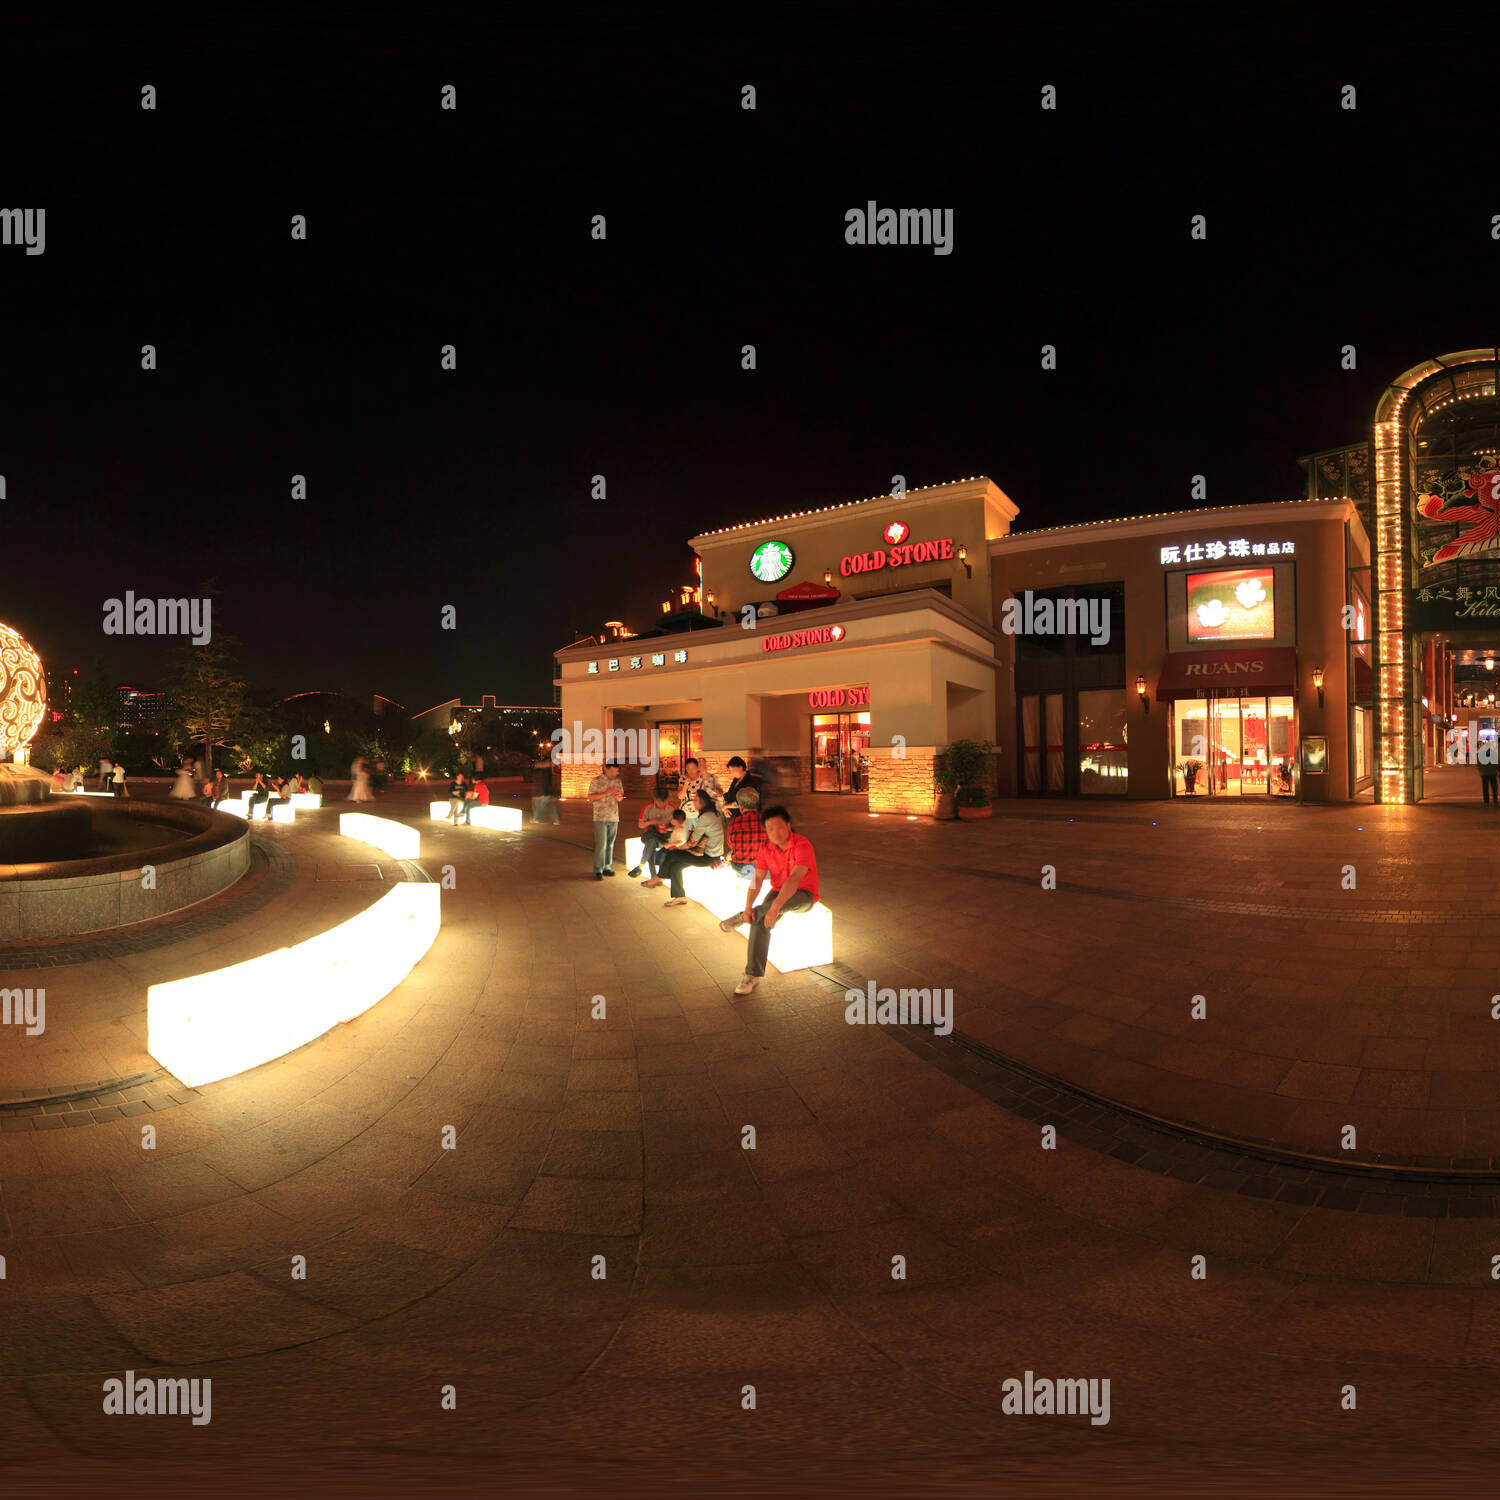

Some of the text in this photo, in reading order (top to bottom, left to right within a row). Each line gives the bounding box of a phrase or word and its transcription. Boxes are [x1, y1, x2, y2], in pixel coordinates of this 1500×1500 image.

[840, 538, 954, 577] COLD STONE
[1160, 538, 1295, 564] 阮仕珍珠精品店
[762, 627, 832, 652] COLD STONE
[587, 649, 688, 674] 星巴克咖啡
[1185, 660, 1265, 676] RUANS
[808, 689, 846, 709] COLD
